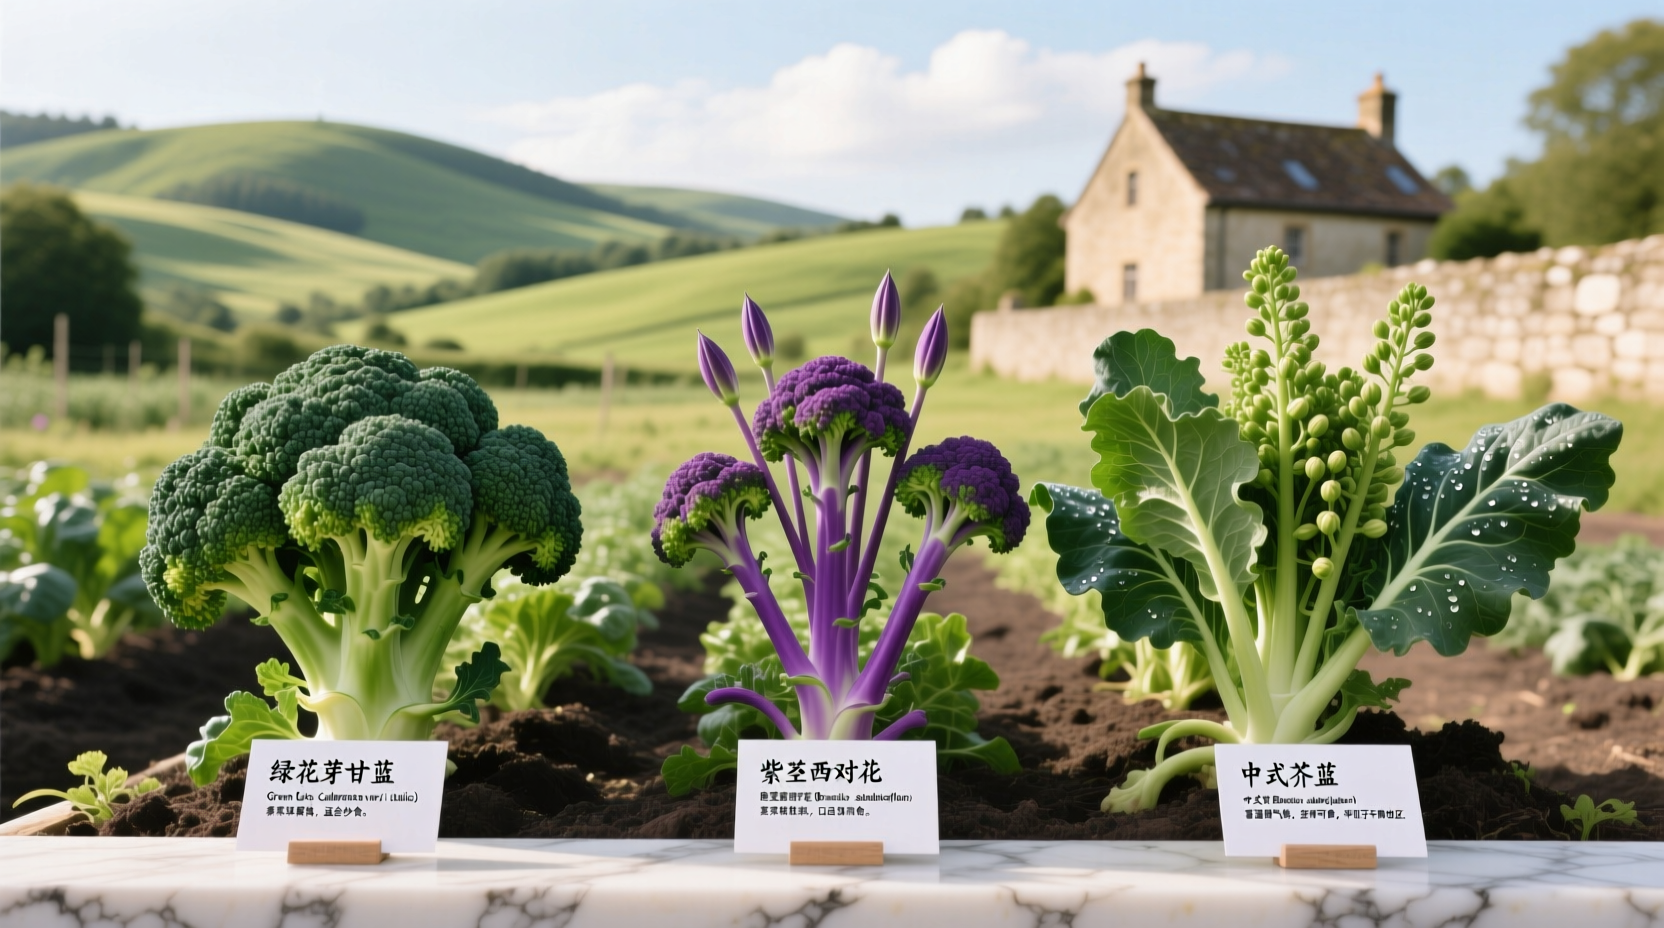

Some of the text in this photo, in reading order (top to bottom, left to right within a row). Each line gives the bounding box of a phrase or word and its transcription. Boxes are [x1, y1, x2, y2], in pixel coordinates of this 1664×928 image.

[269, 759, 395, 785] 绿花芽甘蓝
[1241, 761, 1339, 788] 中式芥蓝
